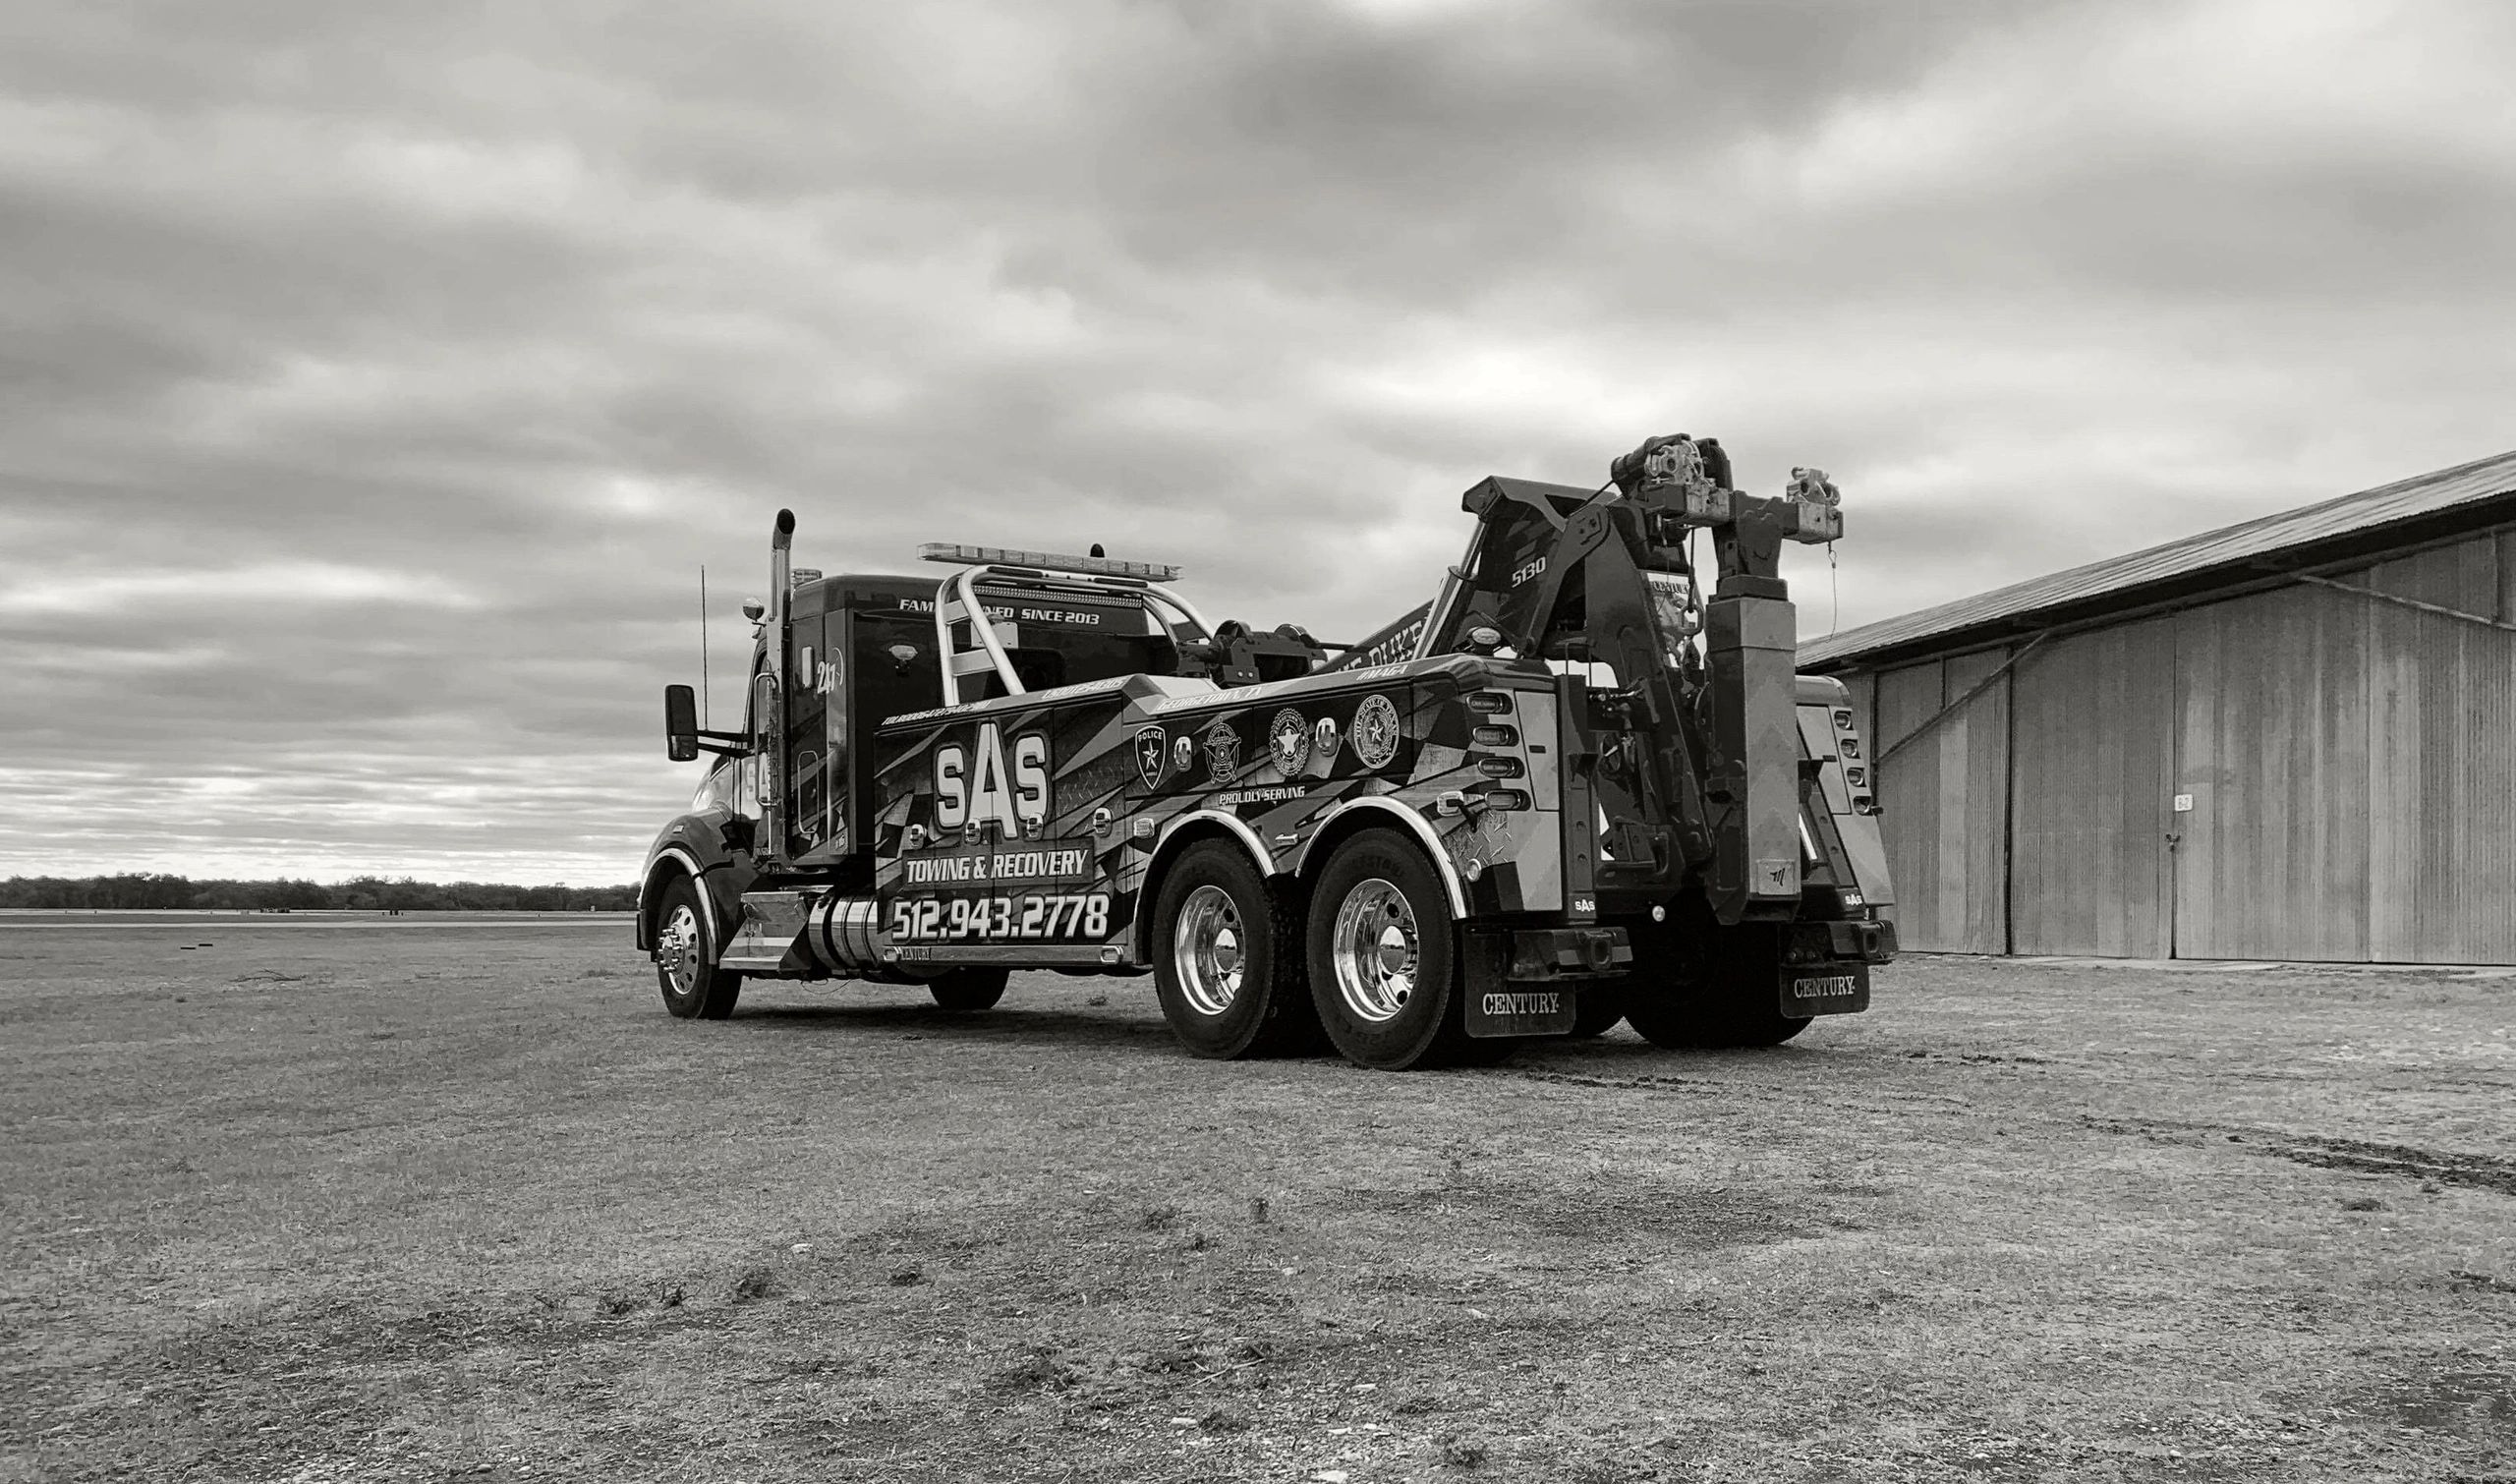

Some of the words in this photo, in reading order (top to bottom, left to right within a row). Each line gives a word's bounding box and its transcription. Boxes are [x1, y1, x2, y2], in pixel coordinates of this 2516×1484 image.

[1512, 556, 1546, 589] 5130
[899, 599, 934, 613] FAM
[1021, 607, 1063, 622] SINCE
[1064, 611, 1100, 625] 2013
[1138, 730, 1163, 743] POLICE
[937, 722, 1048, 838] SAS
[1263, 785, 1306, 802] SERVING
[906, 857, 971, 884] TOWING
[973, 855, 987, 880] &
[991, 849, 1089, 880] RECOVERY
[1574, 898, 1596, 912] SAS
[1845, 893, 1863, 906] SAS
[891, 893, 1111, 941] 512.943.2778
[1794, 975, 1856, 999] CENTURY
[1482, 993, 1559, 1016] CENTURY
